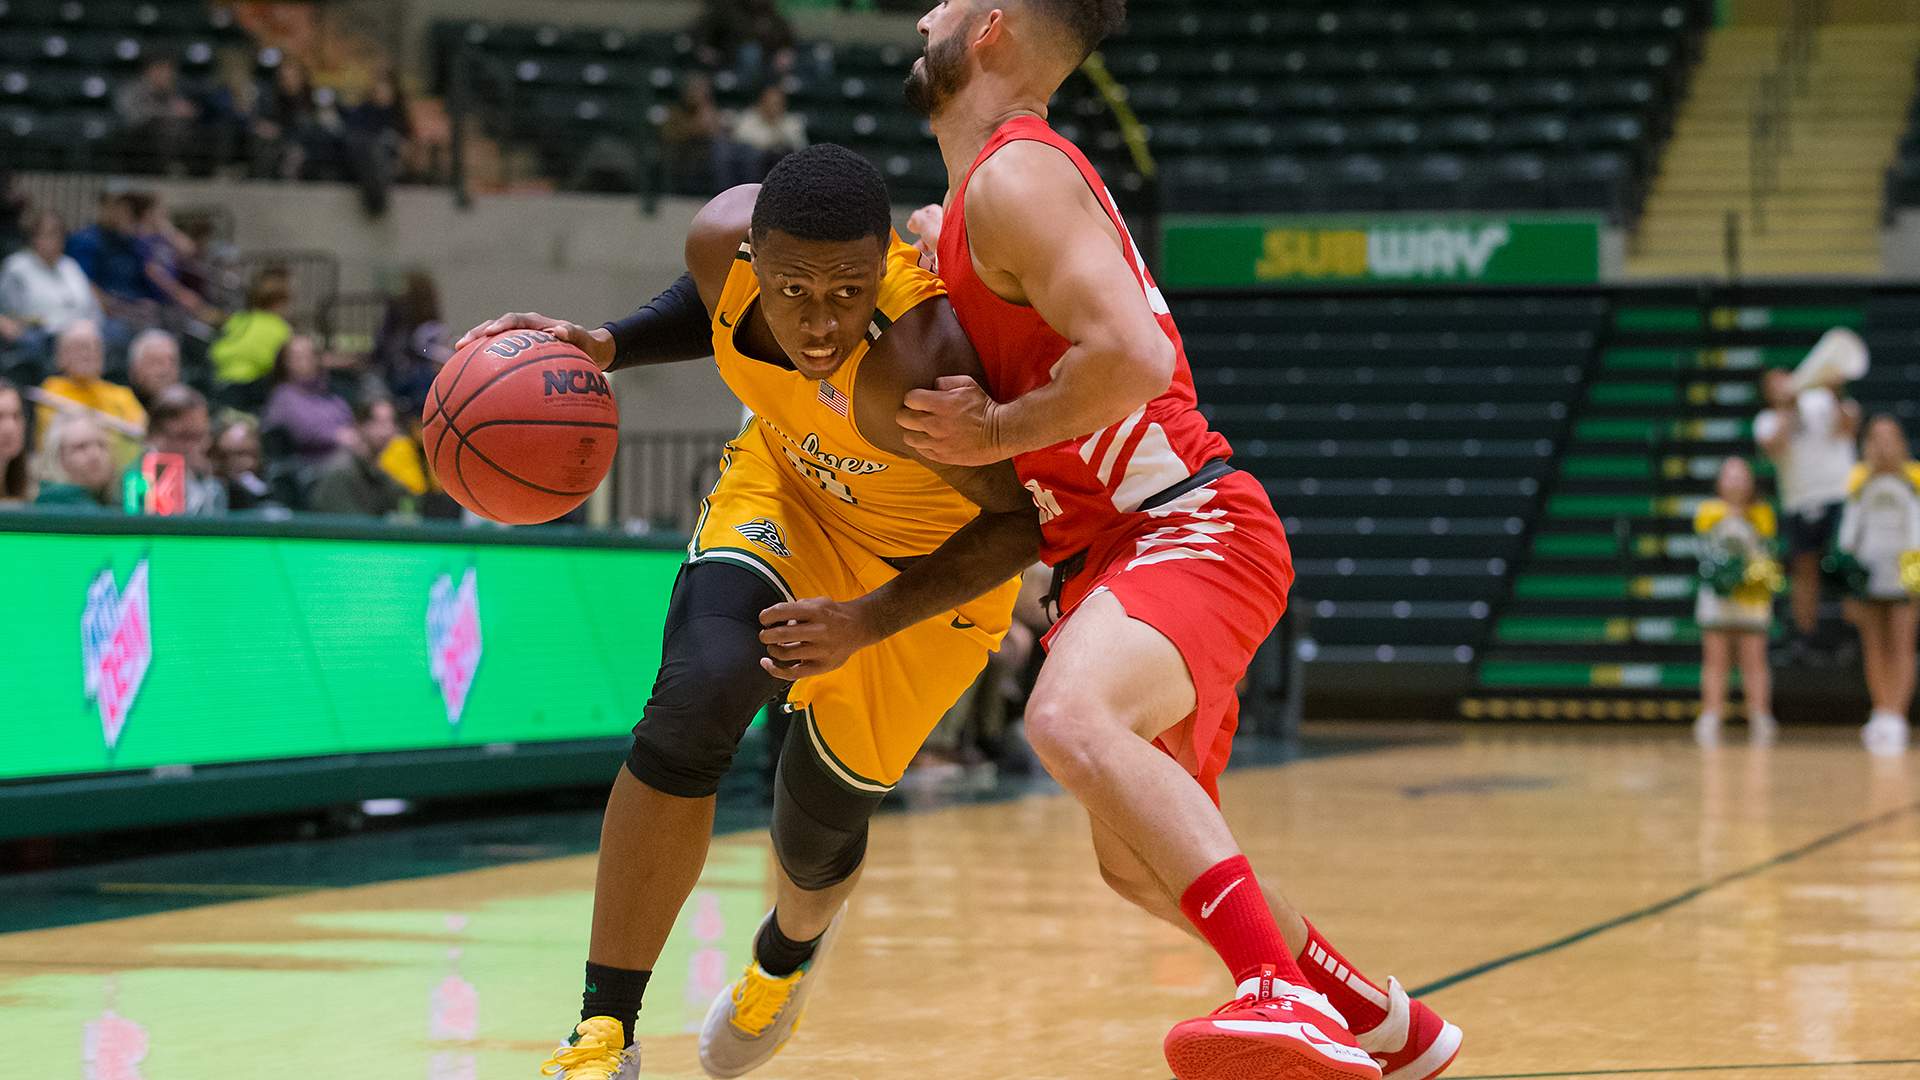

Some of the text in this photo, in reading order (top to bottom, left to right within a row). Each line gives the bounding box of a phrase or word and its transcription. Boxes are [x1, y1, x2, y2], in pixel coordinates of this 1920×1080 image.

[1256, 226, 1509, 279] SUBWAY
[543, 370, 611, 400] NCAA
[1261, 979, 1270, 1000] GEO
